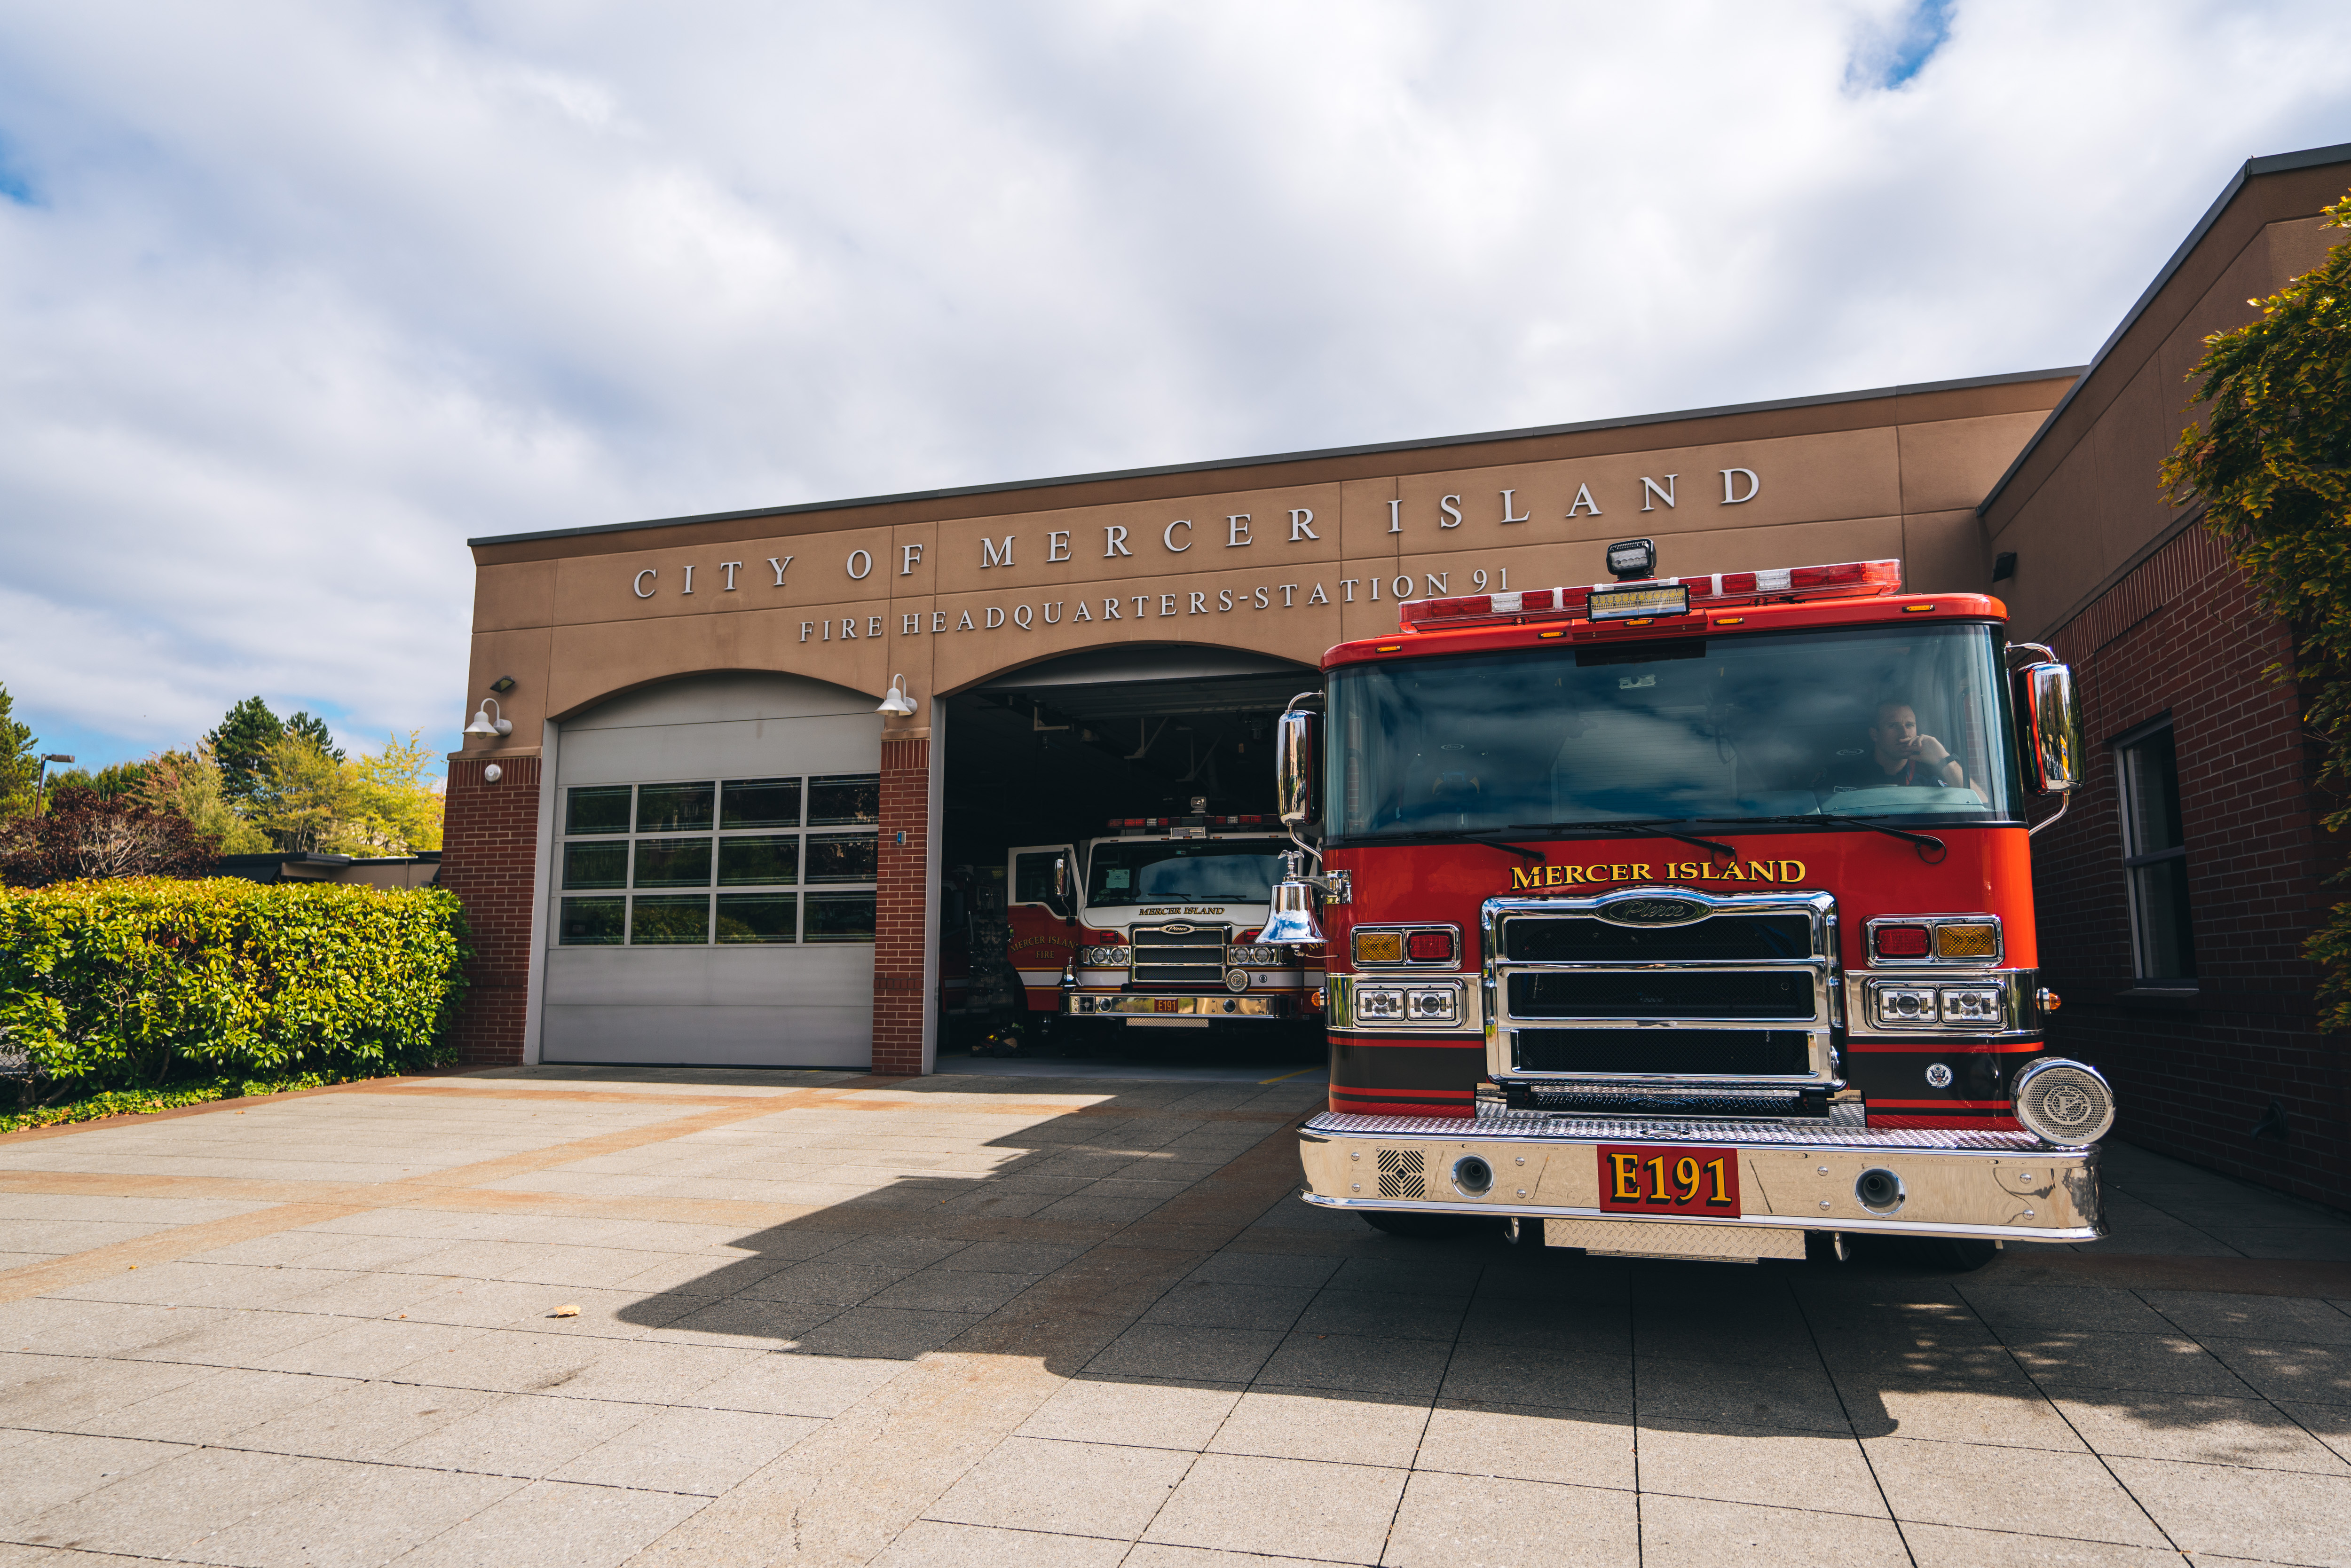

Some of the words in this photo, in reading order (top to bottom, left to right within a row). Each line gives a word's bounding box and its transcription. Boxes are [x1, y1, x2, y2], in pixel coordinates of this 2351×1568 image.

[633, 556, 794, 598] CITY
[846, 544, 923, 579] OF
[980, 508, 1319, 568] MERCER
[1387, 468, 1759, 533] ISLAND
[799, 616, 883, 642] FIRE
[1473, 567, 1509, 593] 91
[1510, 863, 1653, 890] MERCER
[1665, 860, 1807, 884] ISLAND
[1621, 901, 1685, 920] Pierce
[1010, 936, 1045, 953] MERCER
[1158, 1000, 1176, 1011] E191
[1608, 1153, 1732, 1206] E191
